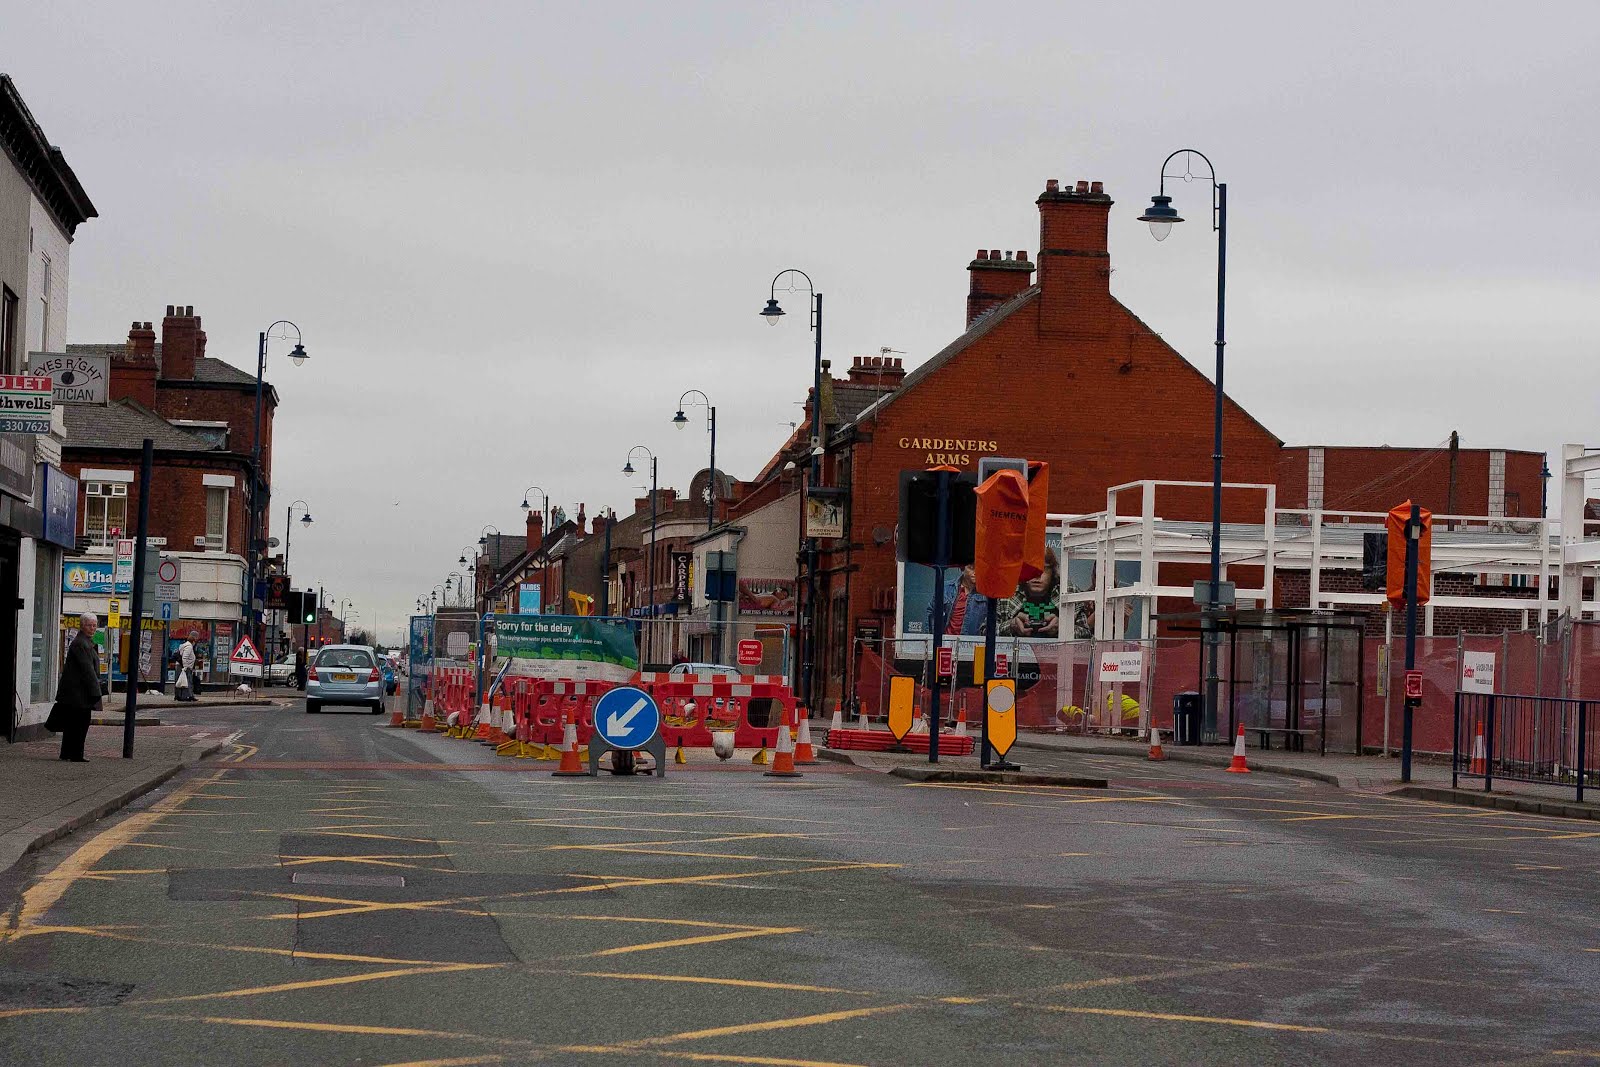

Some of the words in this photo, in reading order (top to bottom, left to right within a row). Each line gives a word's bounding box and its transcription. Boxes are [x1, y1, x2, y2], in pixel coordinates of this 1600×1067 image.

[33, 358, 62, 377] EYES
[12, 377, 46, 390] LET
[25, 421, 49, 432] 7625
[898, 437, 998, 452] GARDENERS
[925, 453, 970, 466] ARMS
[990, 510, 1027, 521] SIEMENS
[72, 568, 131, 584] Altha
[677, 555, 687, 600] CARPETS
[496, 620, 520, 633] Sorry
[520, 621, 533, 632] for
[534, 622, 549, 632] the
[550, 622, 573, 635] delay
[239, 665, 254, 673] End
[1101, 662, 1119, 672] Seddon
